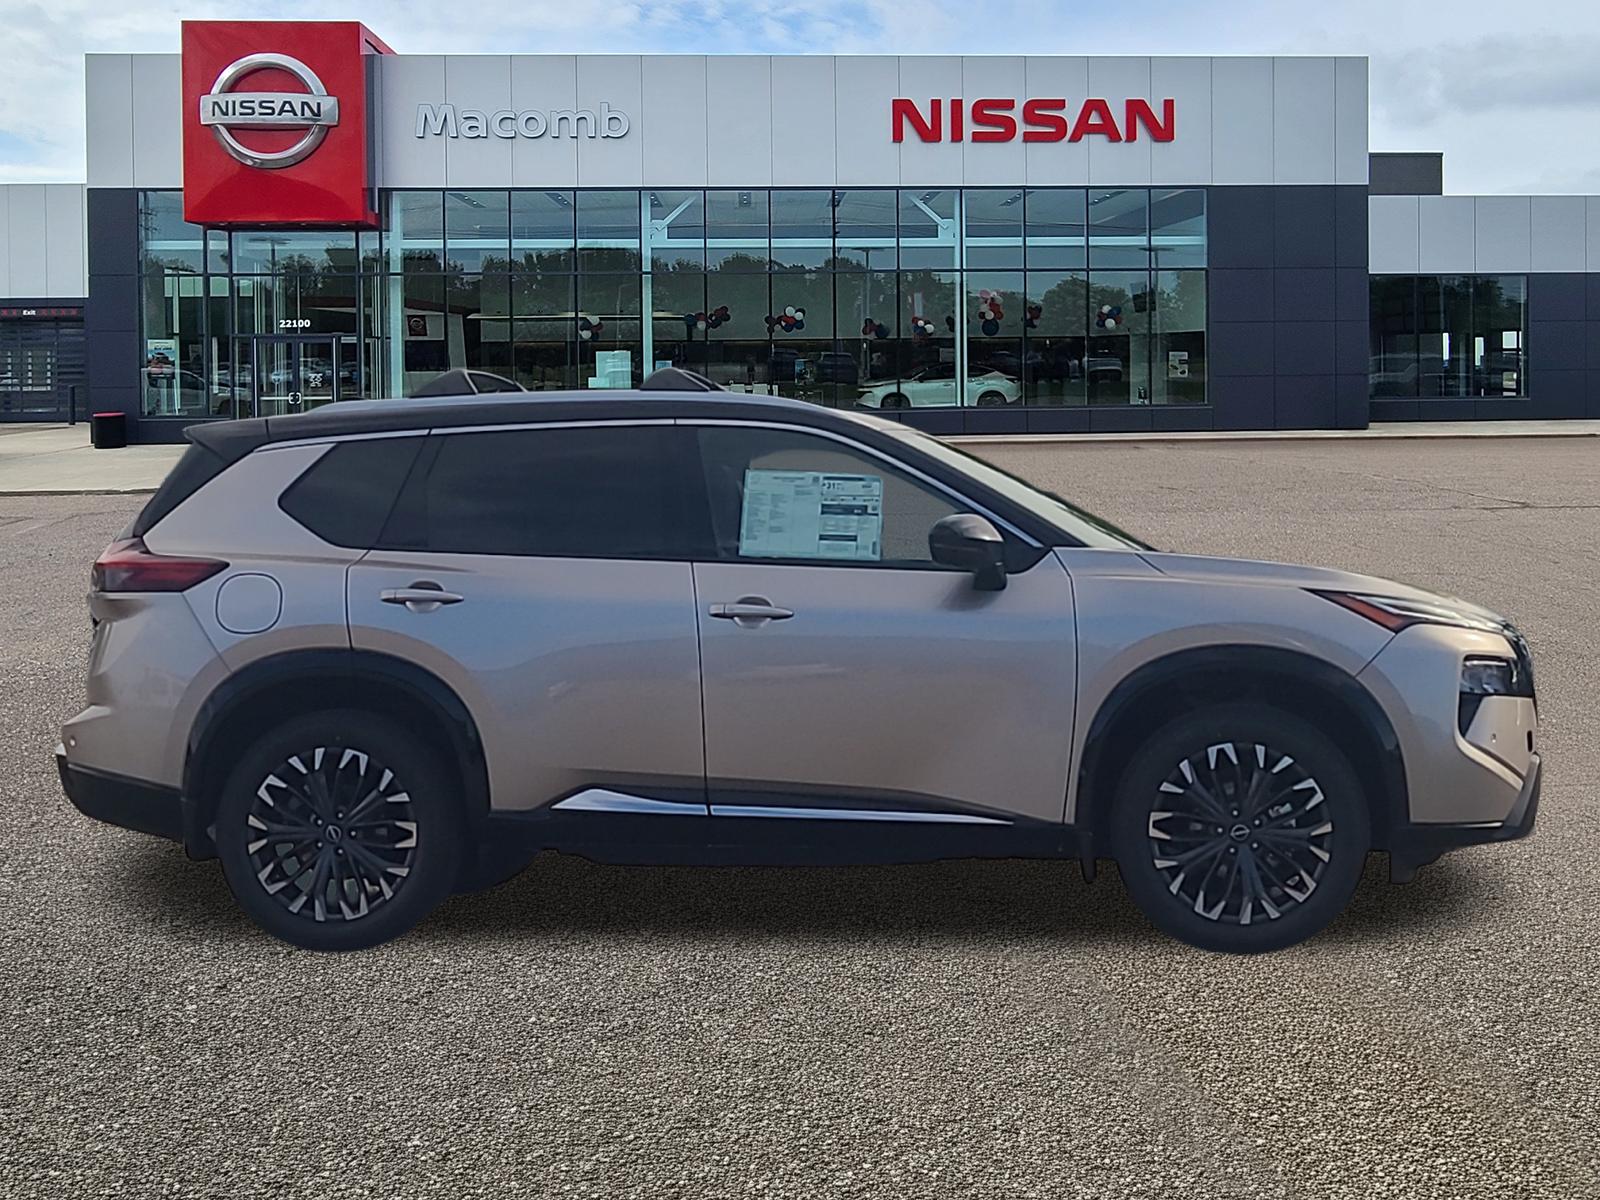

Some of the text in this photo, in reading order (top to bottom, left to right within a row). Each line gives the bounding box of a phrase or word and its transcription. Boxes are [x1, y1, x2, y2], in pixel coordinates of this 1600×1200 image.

[212, 100, 321, 118] NISSAN
[415, 102, 629, 139] Macomb
[892, 98, 1175, 143] NISSAN
[279, 319, 311, 328] 22100
